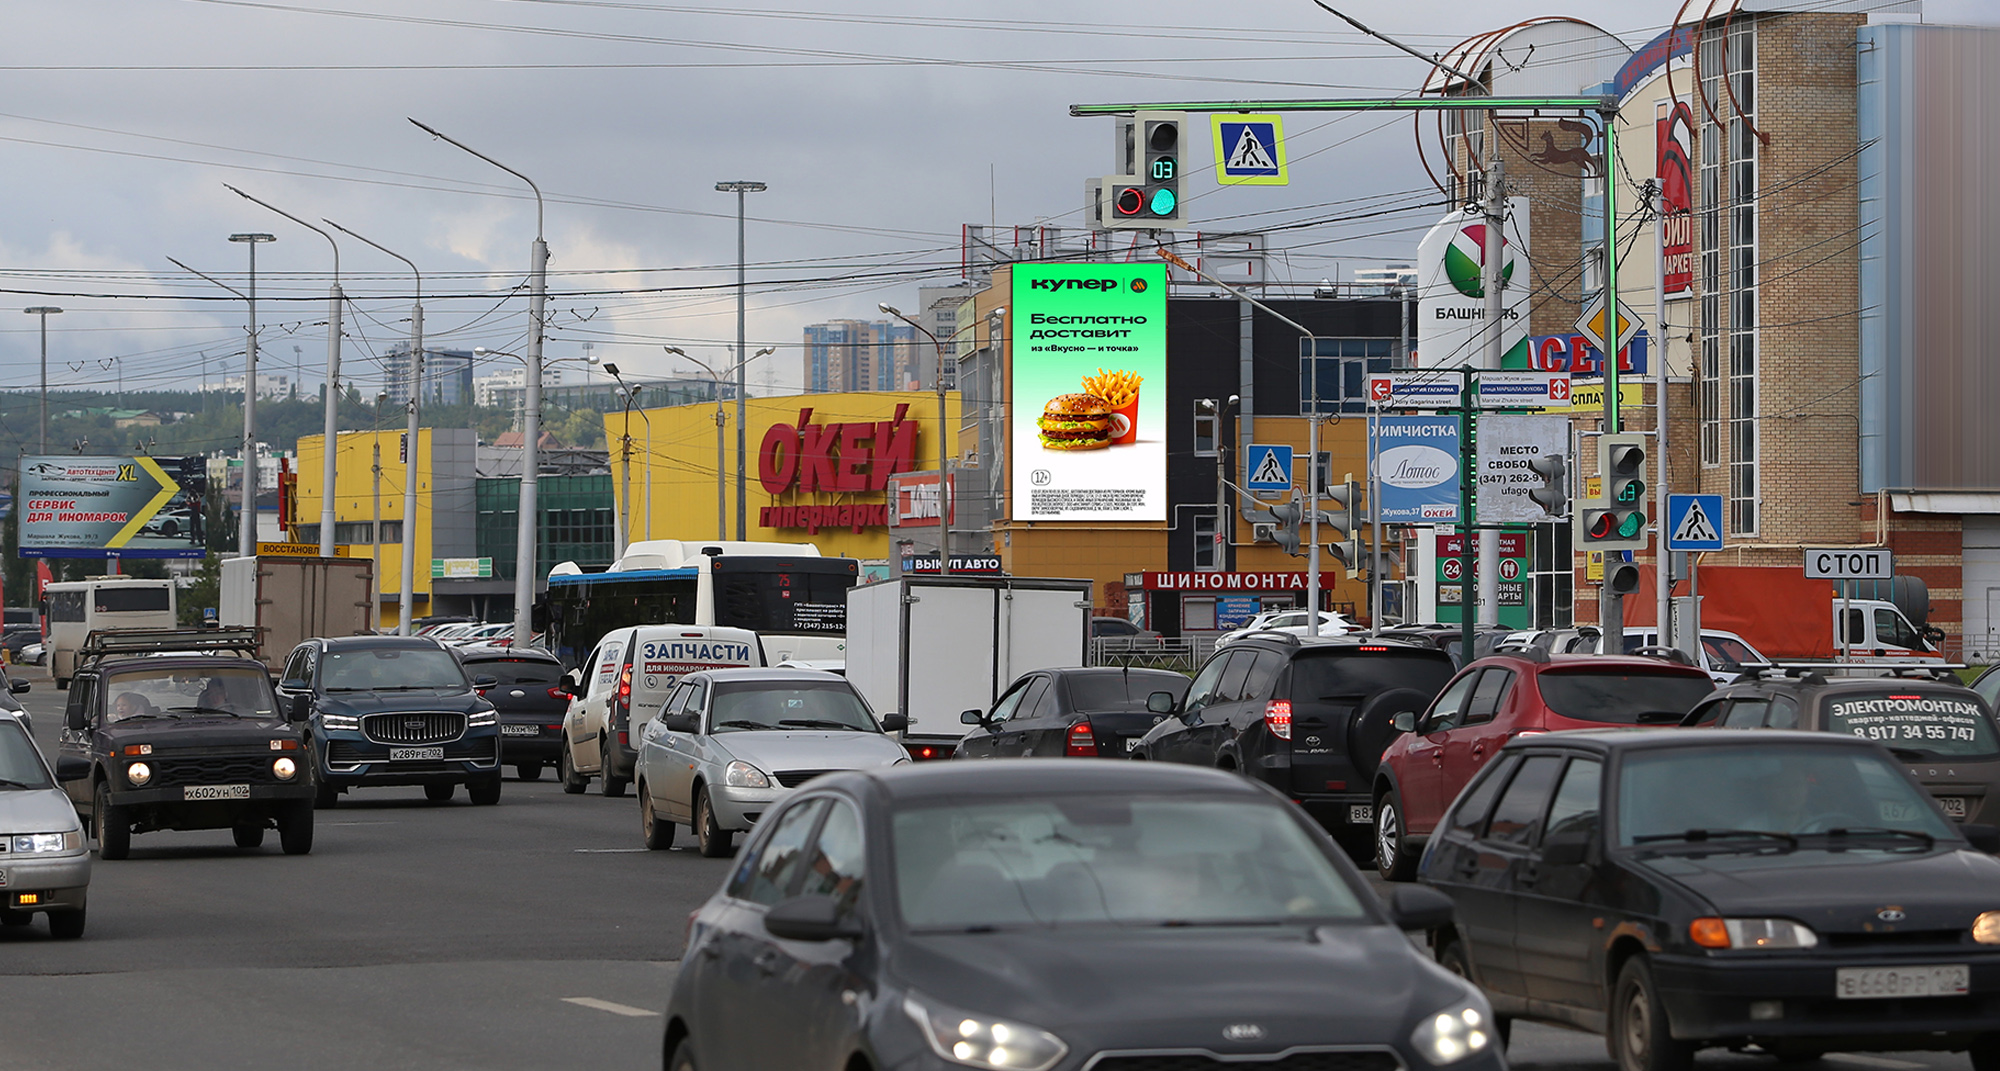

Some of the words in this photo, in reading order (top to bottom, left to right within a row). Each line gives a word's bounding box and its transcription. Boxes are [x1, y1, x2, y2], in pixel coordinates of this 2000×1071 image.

[1152, 161, 1173, 179] 03
[1031, 278, 1118, 292] купер
[1030, 313, 1147, 325] Бесплатно
[1435, 307, 1519, 320] БАШНТЬ
[1029, 329, 1132, 340] доставит
[1044, 344, 1086, 353] «Вкусно
[1571, 391, 1624, 405] СПЛАТО
[1500, 446, 1539, 455] МЕСТО
[1390, 458, 1440, 479] Лотос
[1488, 460, 1528, 469] СВОБО
[116, 464, 138, 482] XL
[1035, 471, 1048, 483] 12+
[1479, 474, 1507, 485] (347)
[1509, 474, 1539, 483] 262-9
[28, 489, 110, 498] ПРОФЕССИОНАЛЬНЫЙ
[1501, 486, 1528, 496] ufago
[28, 500, 76, 511] СЕРВИС
[27, 513, 53, 524] ДЛЯ
[57, 512, 127, 523] ИНОМАРОК
[759, 503, 888, 535] гипермарк
[263, 544, 341, 556] ВОССТАНОВЛЕ
[915, 559, 962, 569] ВЫКП
[964, 558, 999, 569] АВТО
[1445, 564, 1460, 575] 24
[1817, 553, 1880, 575] СТОП
[778, 573, 791, 587] 75
[1498, 592, 1522, 600] АРТЫ
[644, 643, 749, 661] ЗАПЧАСТИ
[646, 664, 662, 672] ДЛЯ
[1832, 699, 1981, 717] ЭЛЕКТРОМОНТАЖ
[1854, 727, 1866, 739] 8
[1869, 725, 1897, 741] 917
[1901, 725, 1923, 739] 34
[1925, 725, 1946, 740] 55
[1947, 726, 1976, 741] 747
[392, 749, 426, 758] К289РЕ
[427, 748, 441, 756] 702
[188, 787, 230, 799] Х602УН
[231, 786, 248, 794] 102
